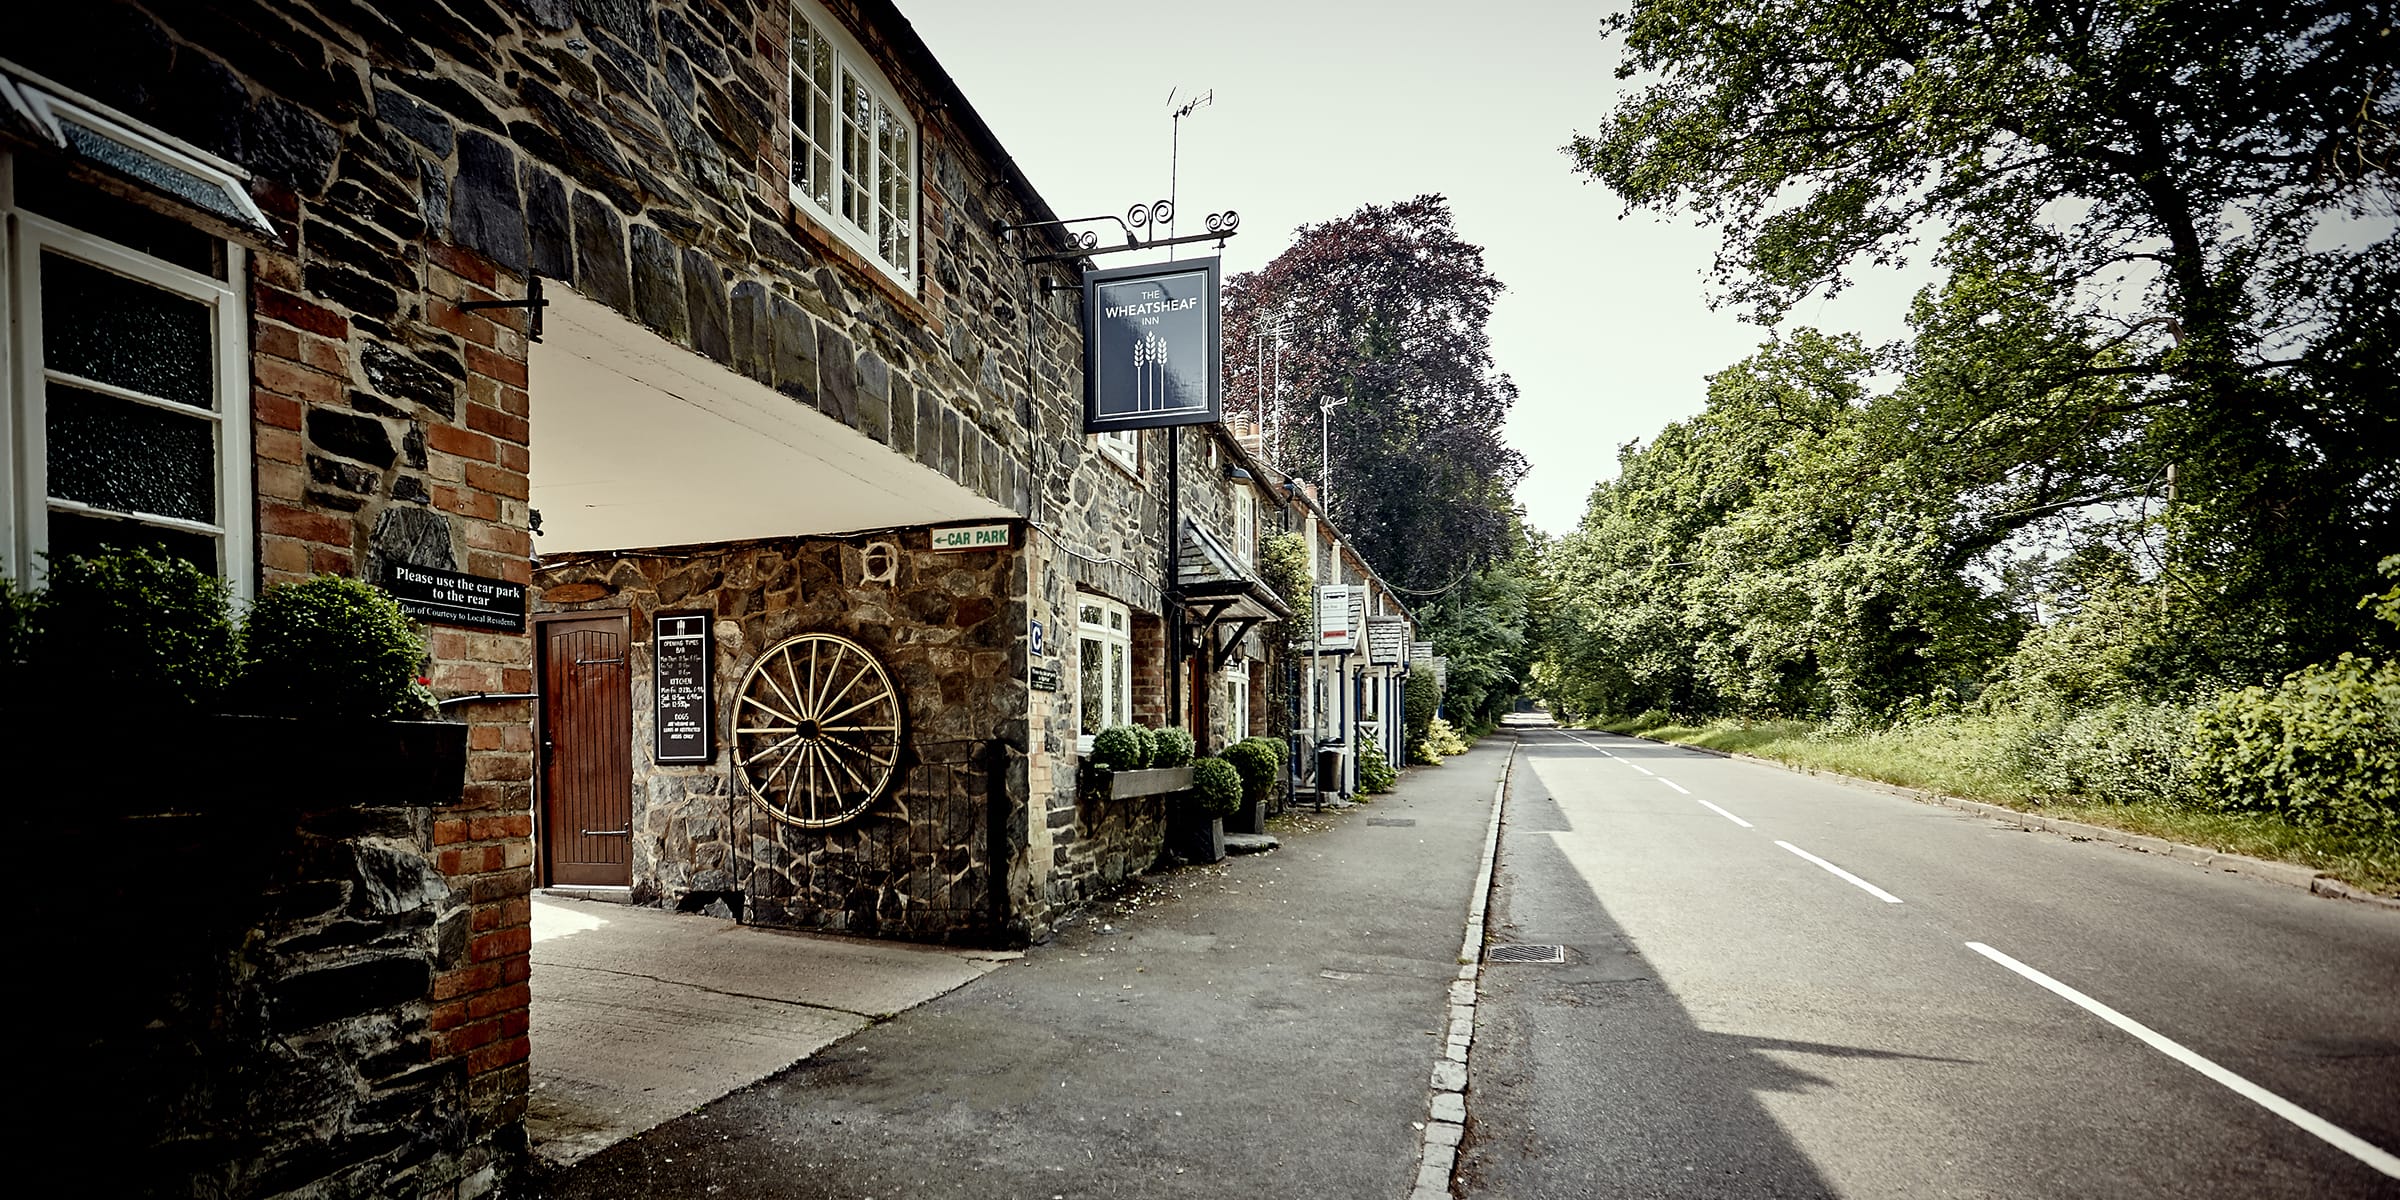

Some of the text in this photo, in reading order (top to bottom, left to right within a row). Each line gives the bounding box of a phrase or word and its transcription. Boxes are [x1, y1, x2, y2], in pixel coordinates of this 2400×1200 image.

[1141, 290, 1160, 300] THE
[1105, 297, 1198, 319] WHEATSHEAF
[1141, 316, 1160, 326] INN
[947, 529, 1007, 546] CAR PARK
[396, 566, 520, 599] Please use the car park
[432, 587, 490, 606] to the rear
[401, 604, 517, 627] Out of Courtesy to Local Residents
[670, 677, 692, 685] KITCHEN
[674, 712, 690, 721] DOGS
